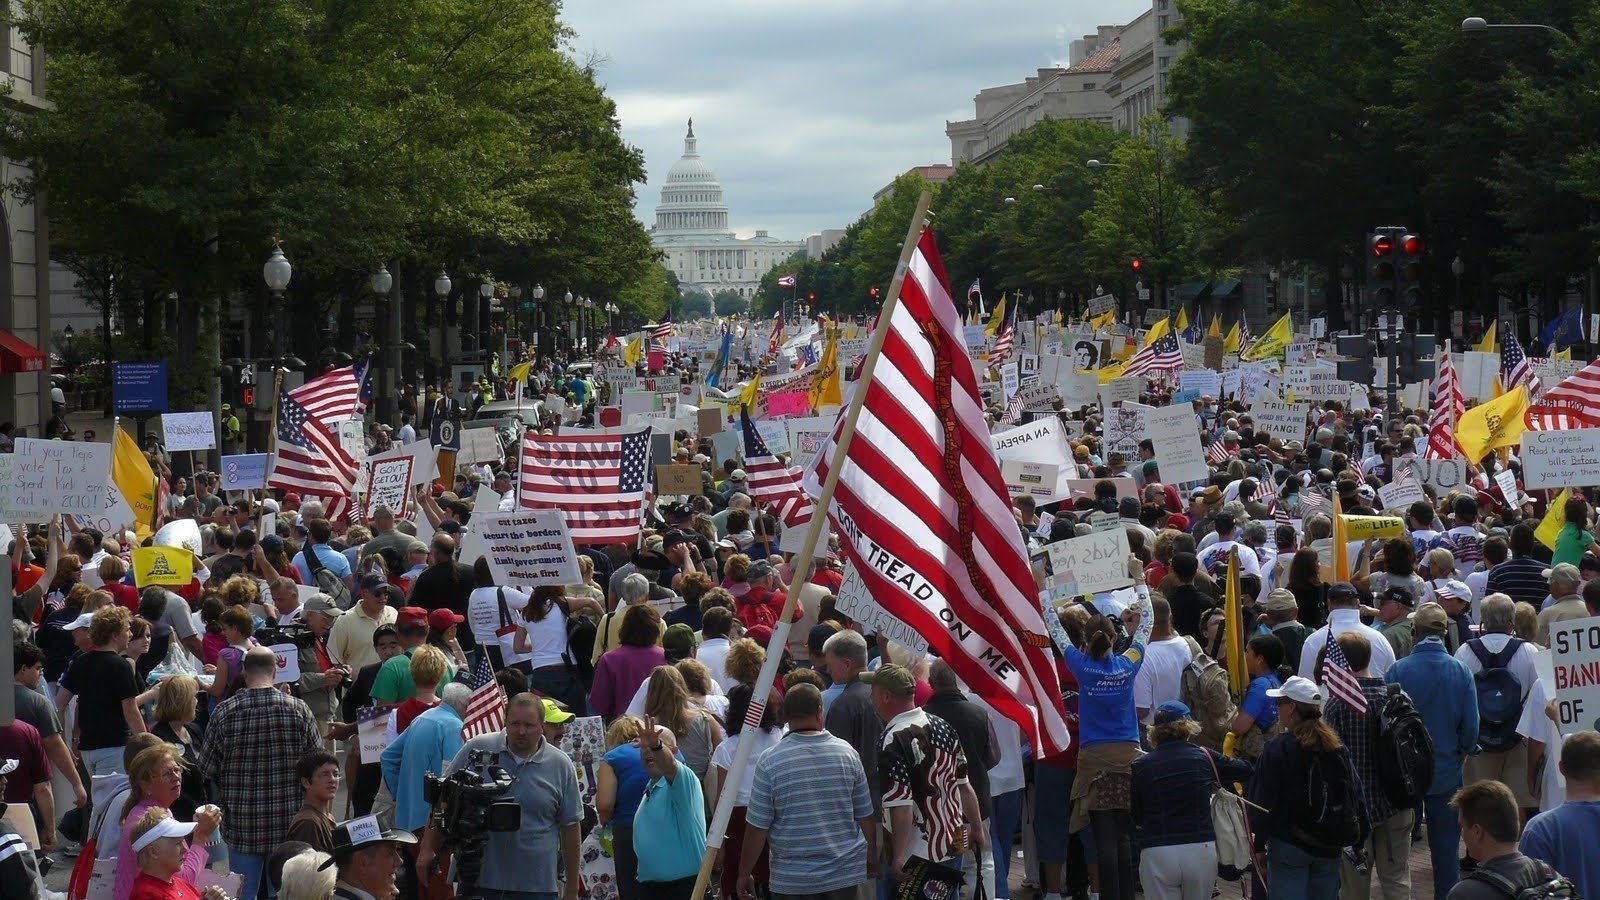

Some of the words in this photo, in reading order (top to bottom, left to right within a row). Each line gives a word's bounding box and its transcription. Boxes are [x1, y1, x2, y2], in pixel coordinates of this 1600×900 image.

[1025, 386, 1048, 399] FIRE
[1311, 385, 1321, 395] TAX
[1327, 384, 1347, 394] SPEND
[1264, 402, 1300, 411] TRUTH
[1260, 424, 1298, 433] CHANGE
[1538, 433, 1582, 445] Congress
[22, 440, 35, 456] If
[43, 448, 64, 461] your
[72, 446, 93, 459] Reps
[1528, 445, 1548, 455] Read
[1559, 444, 1594, 454] understand
[1107, 452, 1140, 461] OmaCa
[1548, 457, 1566, 466] bills
[1571, 455, 1599, 465] Before
[20, 460, 45, 473] vote
[55, 460, 72, 474] Tax
[374, 476, 389, 484] GET
[390, 473, 406, 482] OUT
[674, 475, 684, 483] NO
[1404, 459, 1460, 488] NO
[1540, 472, 1557, 482] you
[1561, 471, 1576, 479] sign
[16, 492, 34, 506] out
[61, 495, 97, 508] 2010!
[498, 518, 512, 526] cut
[512, 517, 537, 526] taxes
[1372, 519, 1399, 530] LIFE
[510, 531, 525, 539] the
[526, 528, 561, 538] borders
[491, 544, 519, 553] control
[520, 542, 563, 554] spending
[494, 557, 514, 565] limit
[514, 556, 567, 567] government
[509, 570, 538, 579] america
[540, 569, 560, 577] first
[842, 572, 867, 598] AM
[868, 542, 934, 601] TREAD
[939, 608, 972, 642] ON
[978, 647, 1016, 680] ME
[836, 590, 859, 617] FOR
[860, 604, 925, 652] QUESTIONING
[1559, 699, 1584, 724] OF
[353, 822, 375, 831] DRILL
[359, 830, 375, 839] NOW
